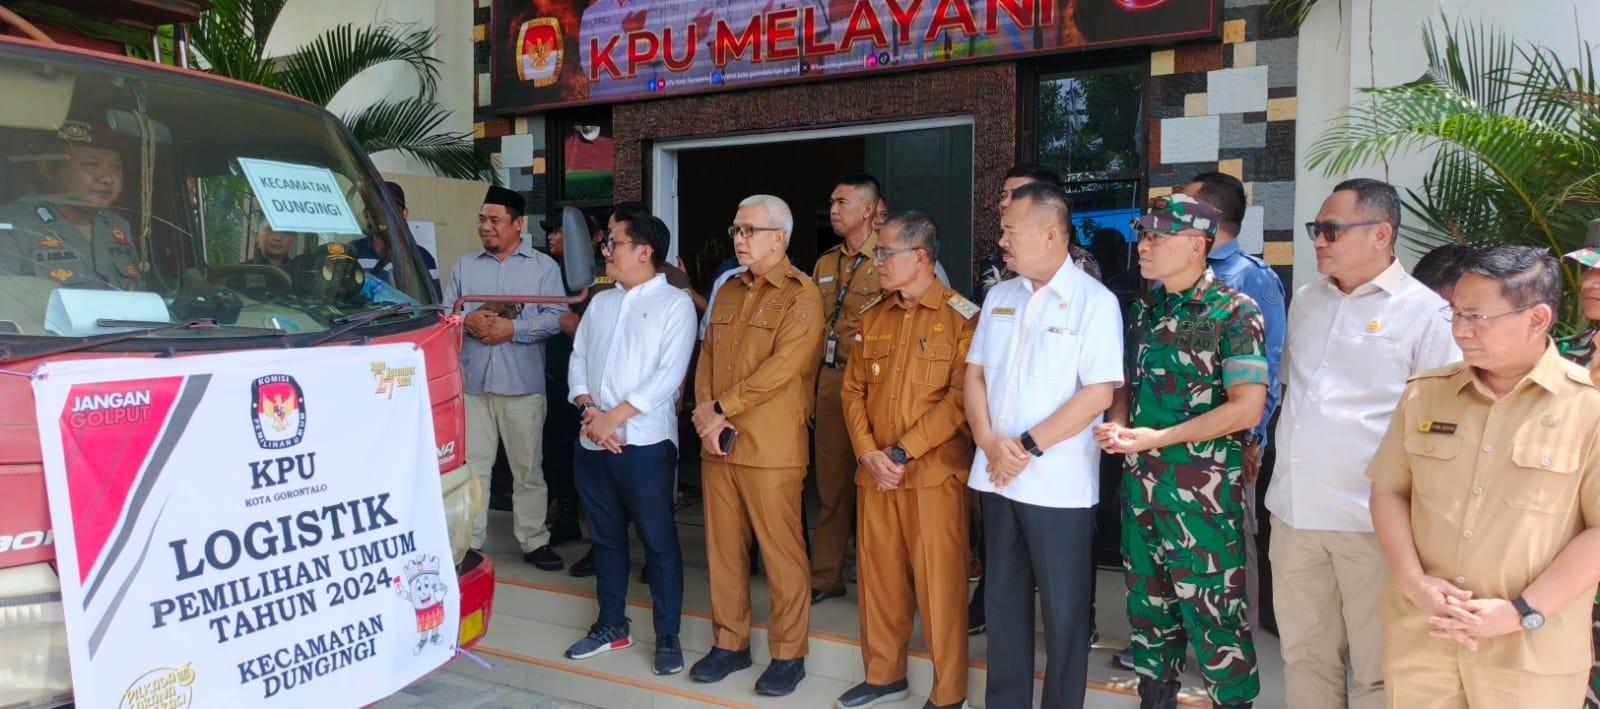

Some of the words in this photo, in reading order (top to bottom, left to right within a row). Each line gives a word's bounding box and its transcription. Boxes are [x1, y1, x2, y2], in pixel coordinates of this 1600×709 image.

[588, 22, 699, 82] KPU
[714, 0, 1054, 69] MELAYANI
[260, 177, 332, 194] KECAMATAN
[271, 199, 342, 216] DUNGINGI
[258, 375, 290, 386] KOMISI
[70, 405, 151, 430] GOLPUT
[71, 389, 151, 413] JANGAN
[248, 451, 316, 490] KPU
[244, 495, 272, 508] KOTA
[273, 483, 328, 502] GORONTALO
[168, 492, 398, 582] LOGISTIK
[149, 554, 332, 630] PEMILIHAN
[338, 530, 417, 572] UMUM
[209, 588, 318, 645] TAHUN
[325, 566, 393, 608] 2024
[236, 614, 385, 685] KECAMATAN
[262, 637, 378, 700] DUNGINGI
